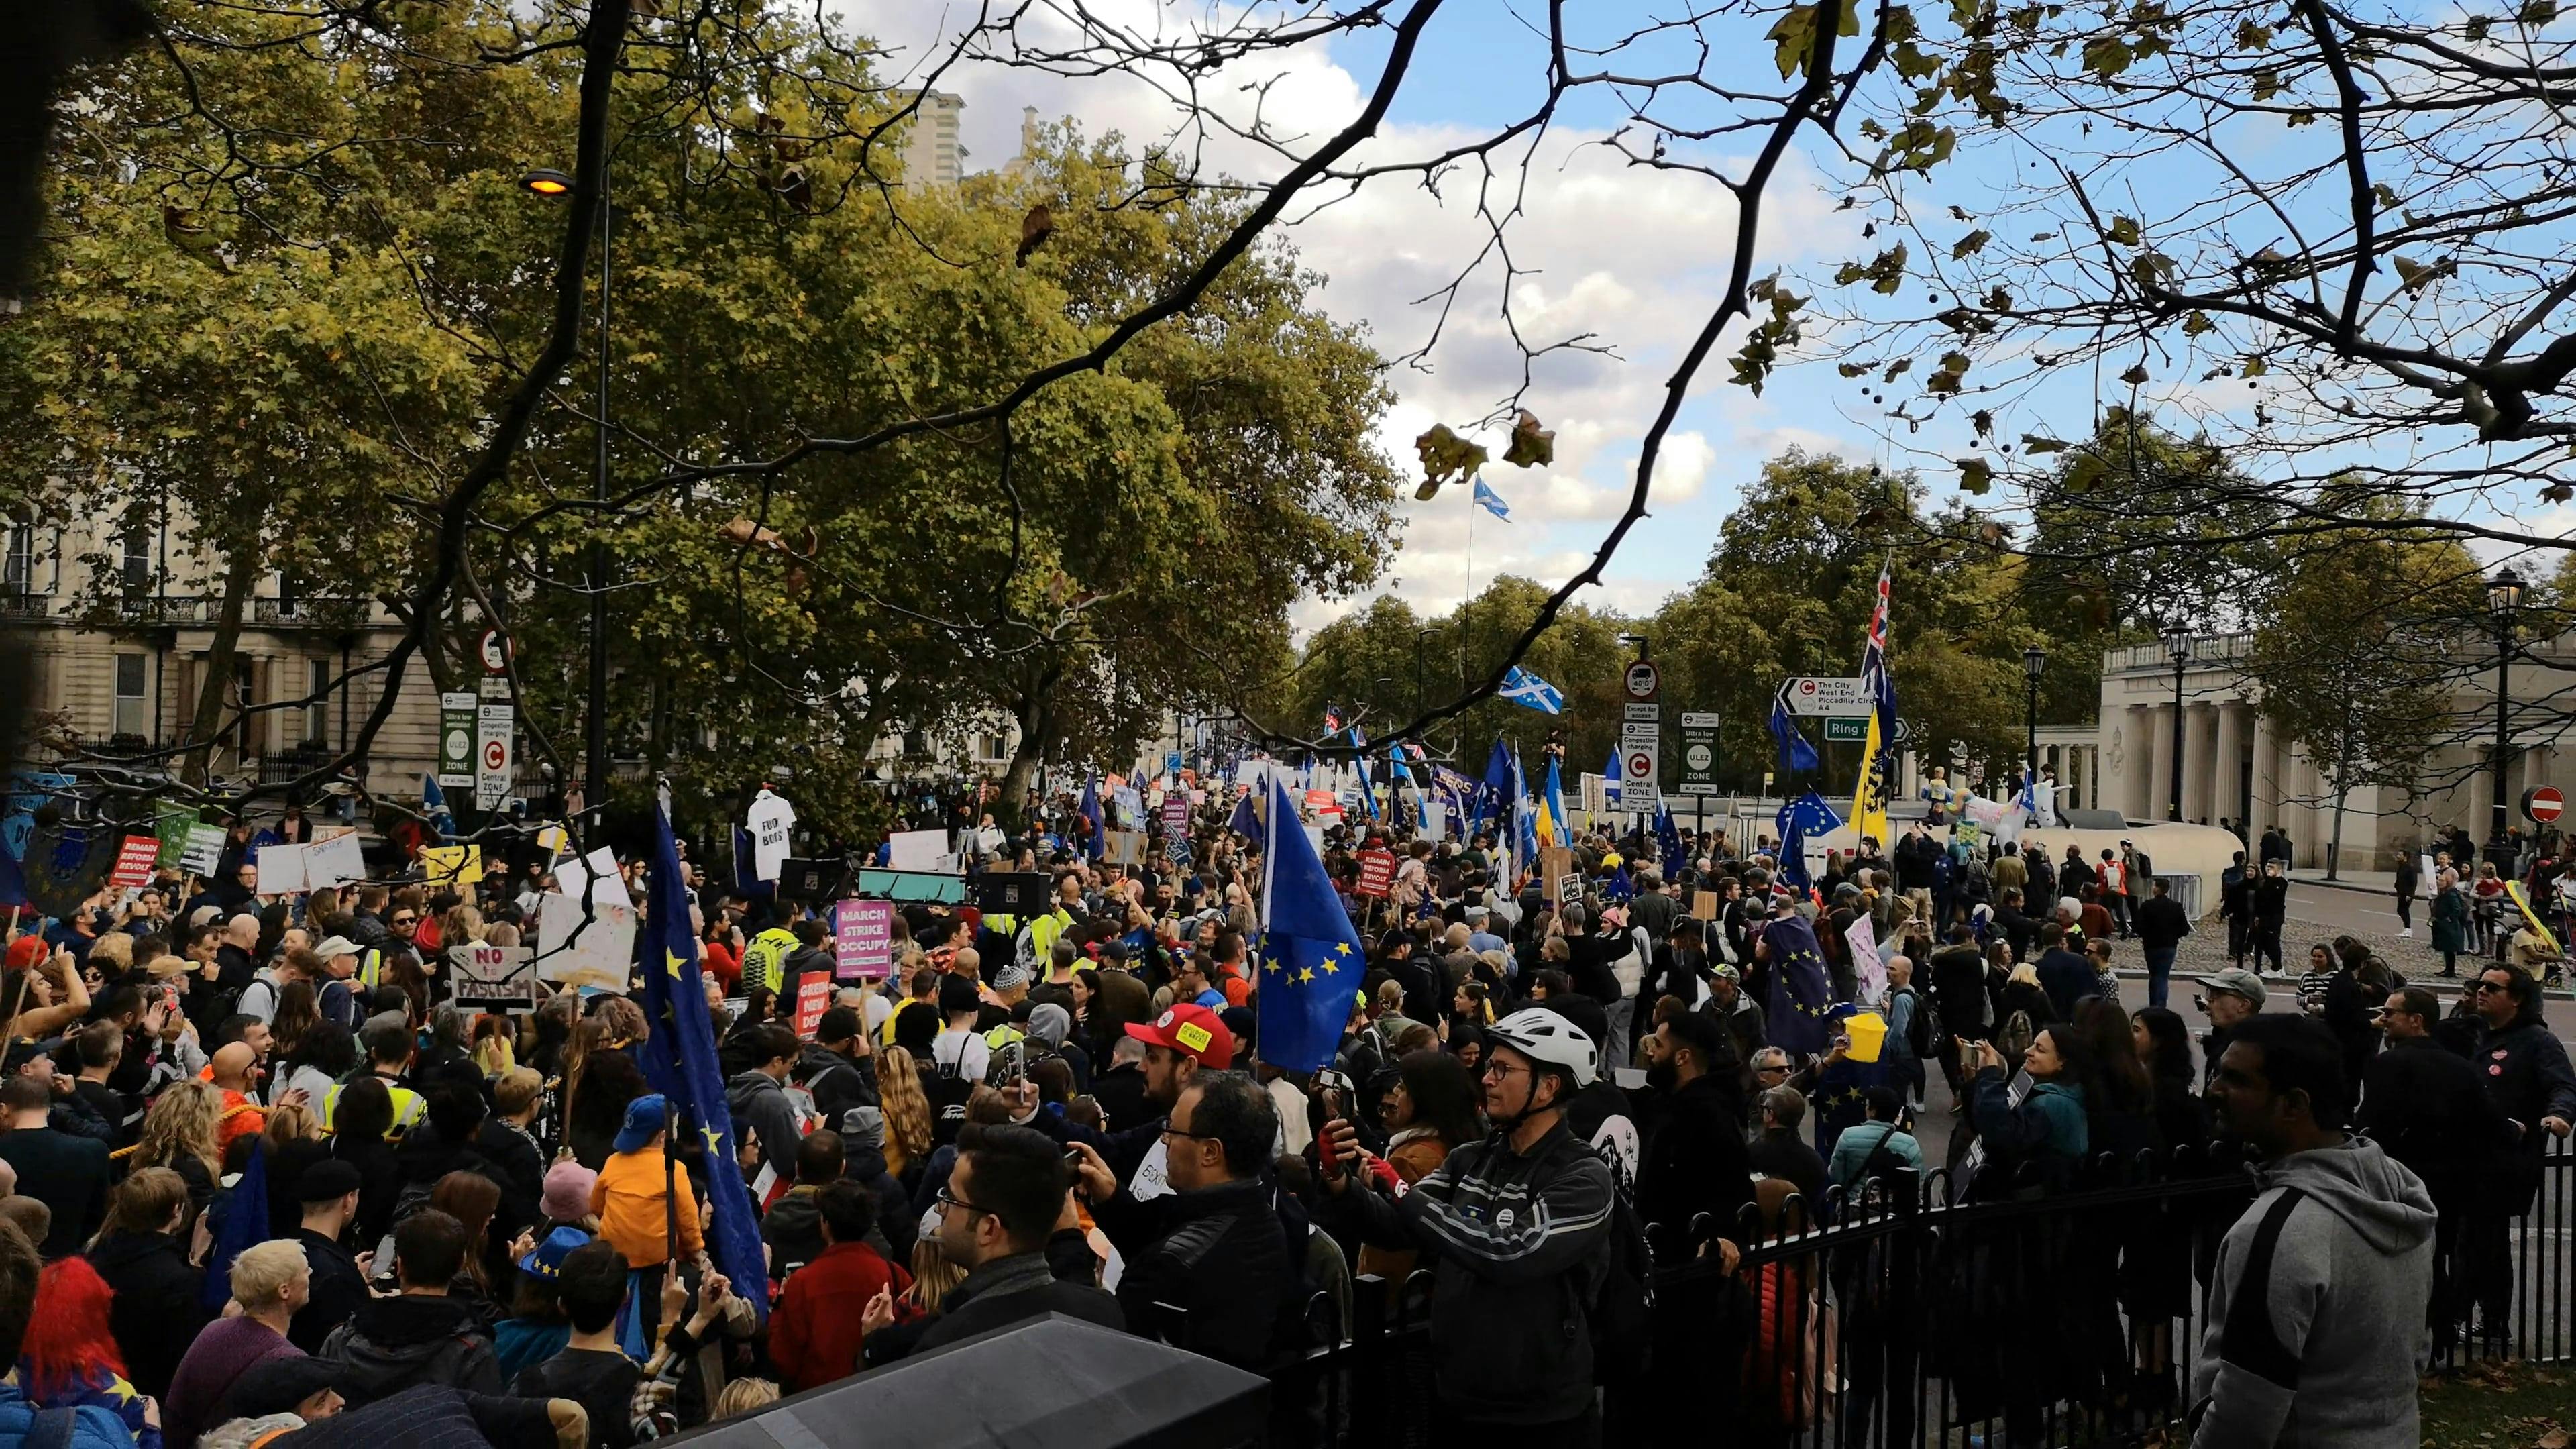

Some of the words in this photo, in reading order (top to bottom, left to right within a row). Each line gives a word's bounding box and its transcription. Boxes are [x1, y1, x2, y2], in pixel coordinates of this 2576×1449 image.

[1835, 682, 1851, 690] City
[1832, 723, 1858, 736] Ring
[446, 762, 468, 771] ZONE
[482, 773, 506, 782] Central
[1686, 772, 1711, 780] ZONE
[484, 783, 503, 792] ZONE
[1625, 780, 1653, 788] Central
[1433, 786, 1448, 799] OR
[1628, 788, 1650, 796] ZONE
[125, 843, 158, 852] REMAIN
[121, 853, 156, 861] REFORM
[1366, 856, 1391, 866] REMAIN
[119, 862, 151, 871] REVOLT
[1364, 865, 1390, 874] REFORM
[1364, 873, 1387, 882] REVOLT
[841, 910, 886, 922] MARCH
[843, 924, 884, 937] STRIKE
[839, 938, 890, 953] OCCUPY
[475, 948, 503, 964] NO
[800, 982, 829, 997] GREEN
[804, 998, 825, 1012] NEW
